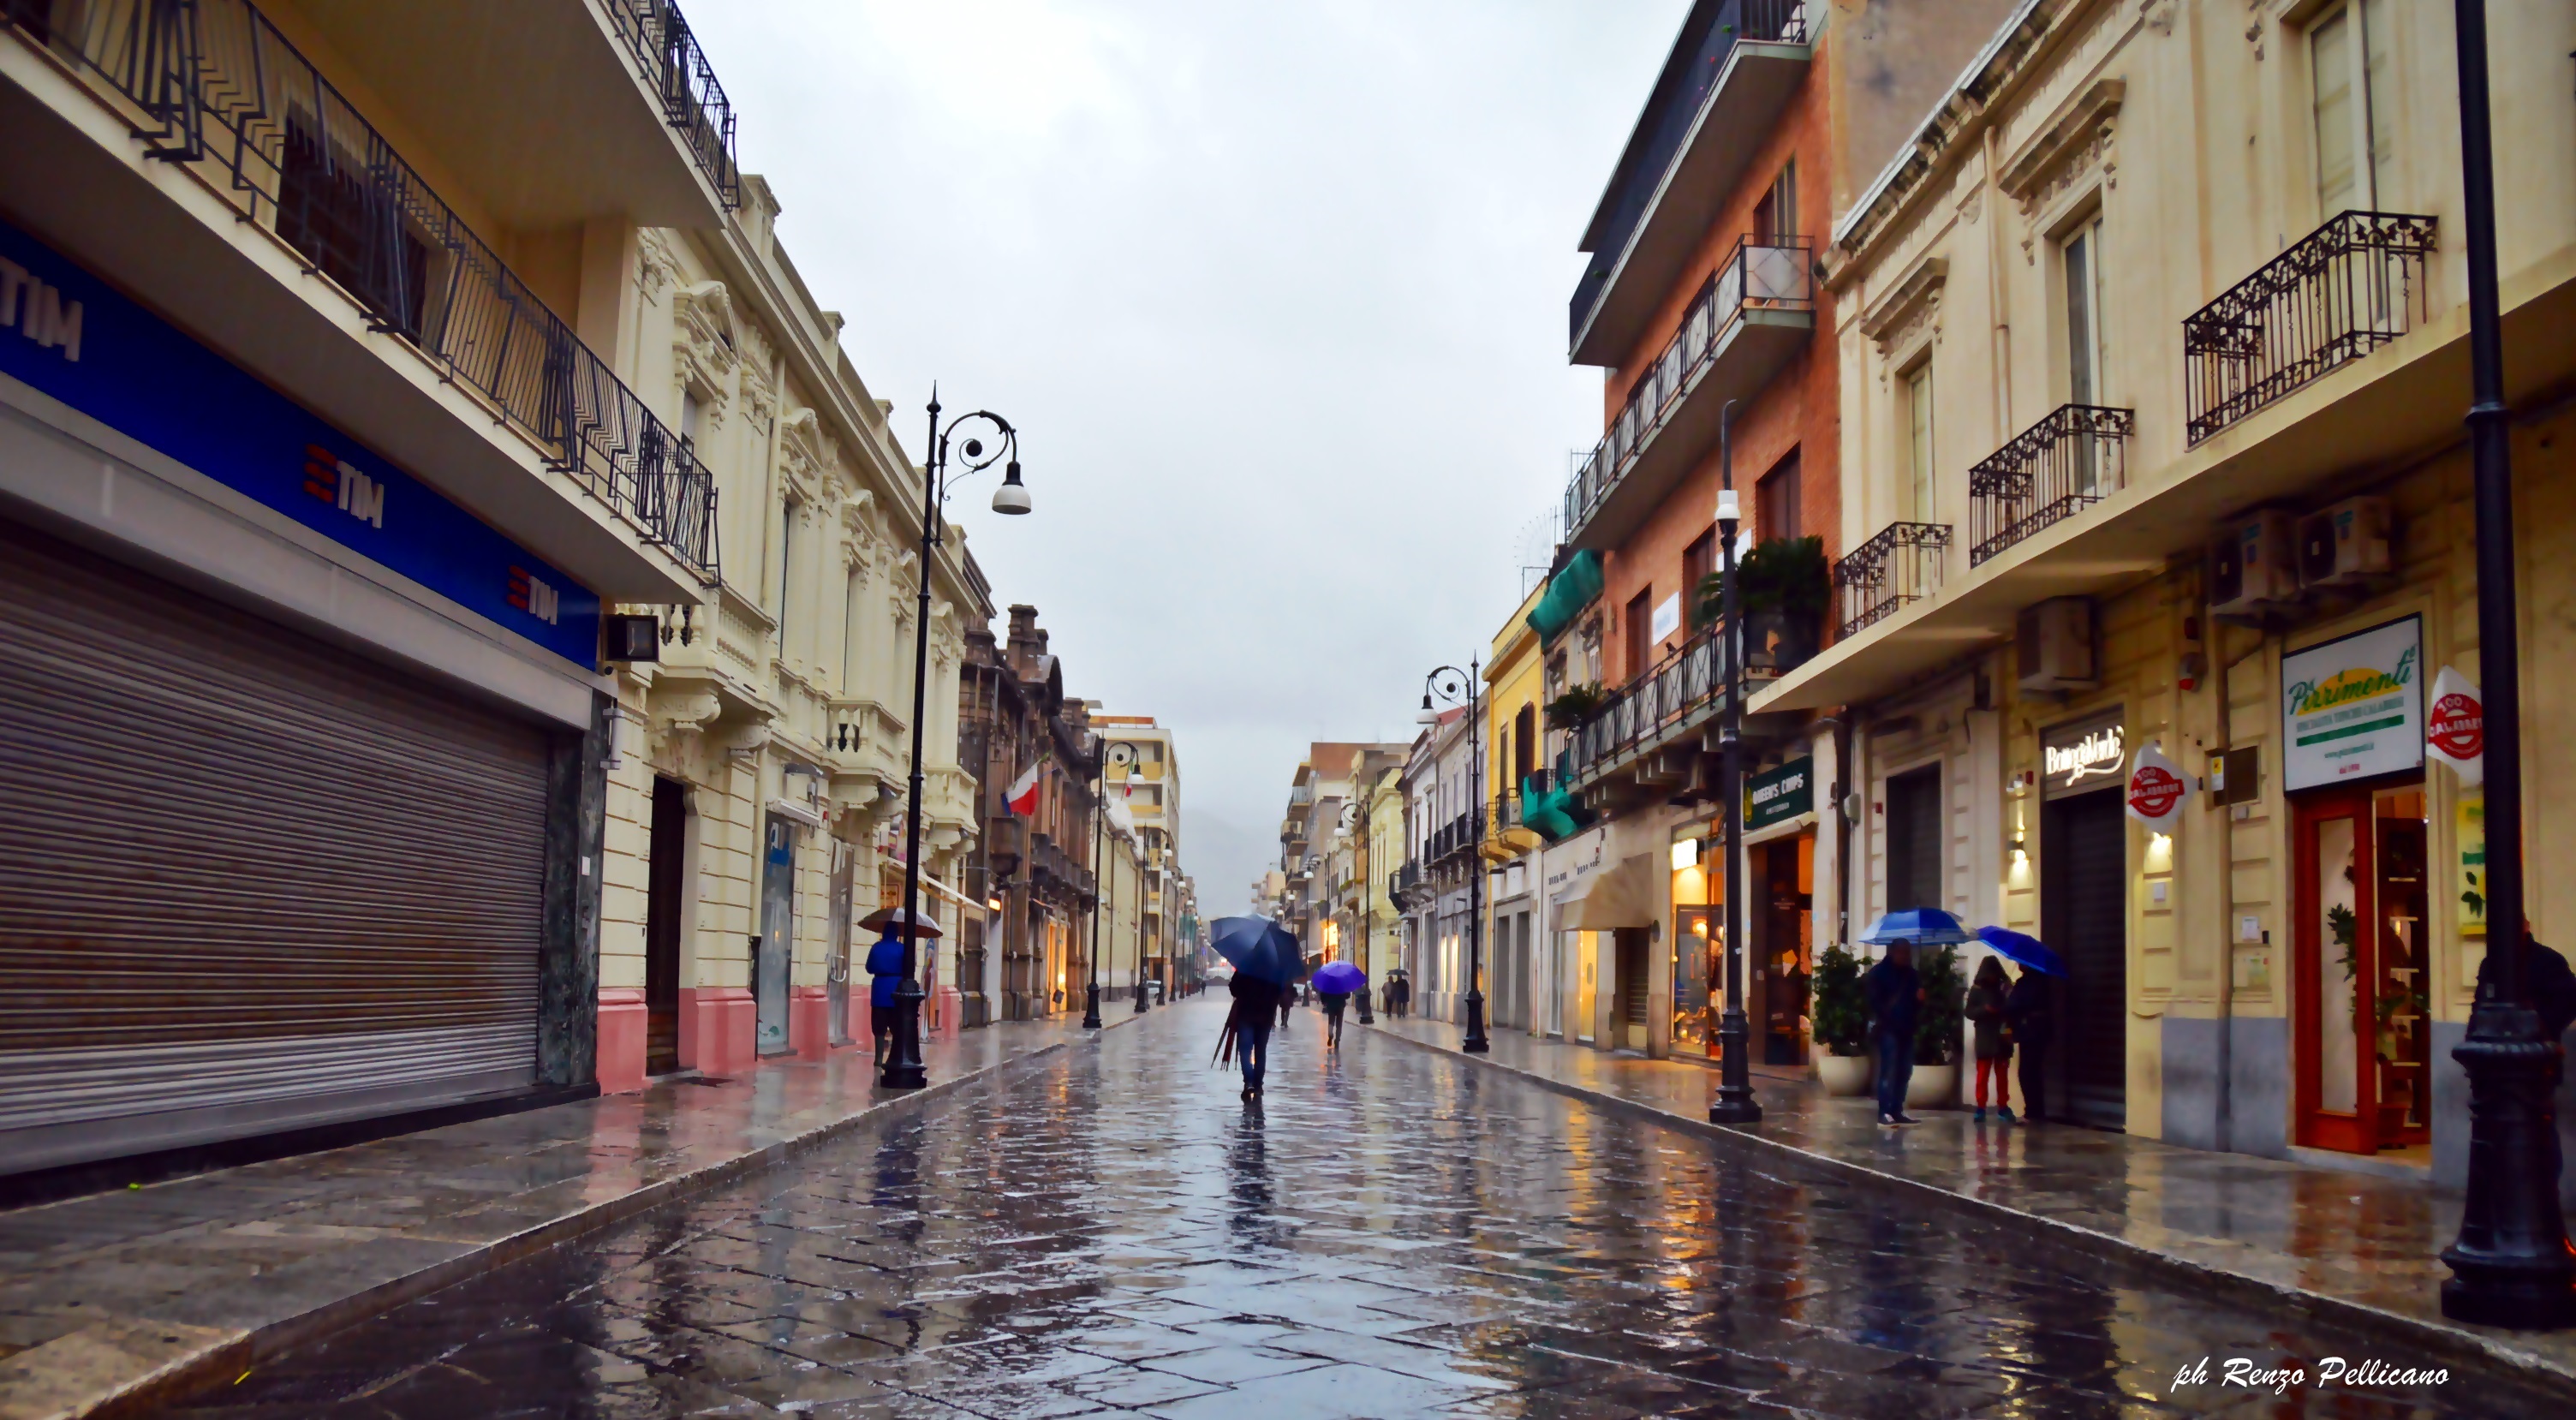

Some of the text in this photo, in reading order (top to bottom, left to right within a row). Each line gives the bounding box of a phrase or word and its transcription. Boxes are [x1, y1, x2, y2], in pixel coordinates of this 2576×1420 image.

[0, 255, 83, 362] TIM
[337, 460, 385, 528] TIM
[528, 576, 558, 626] TIM
